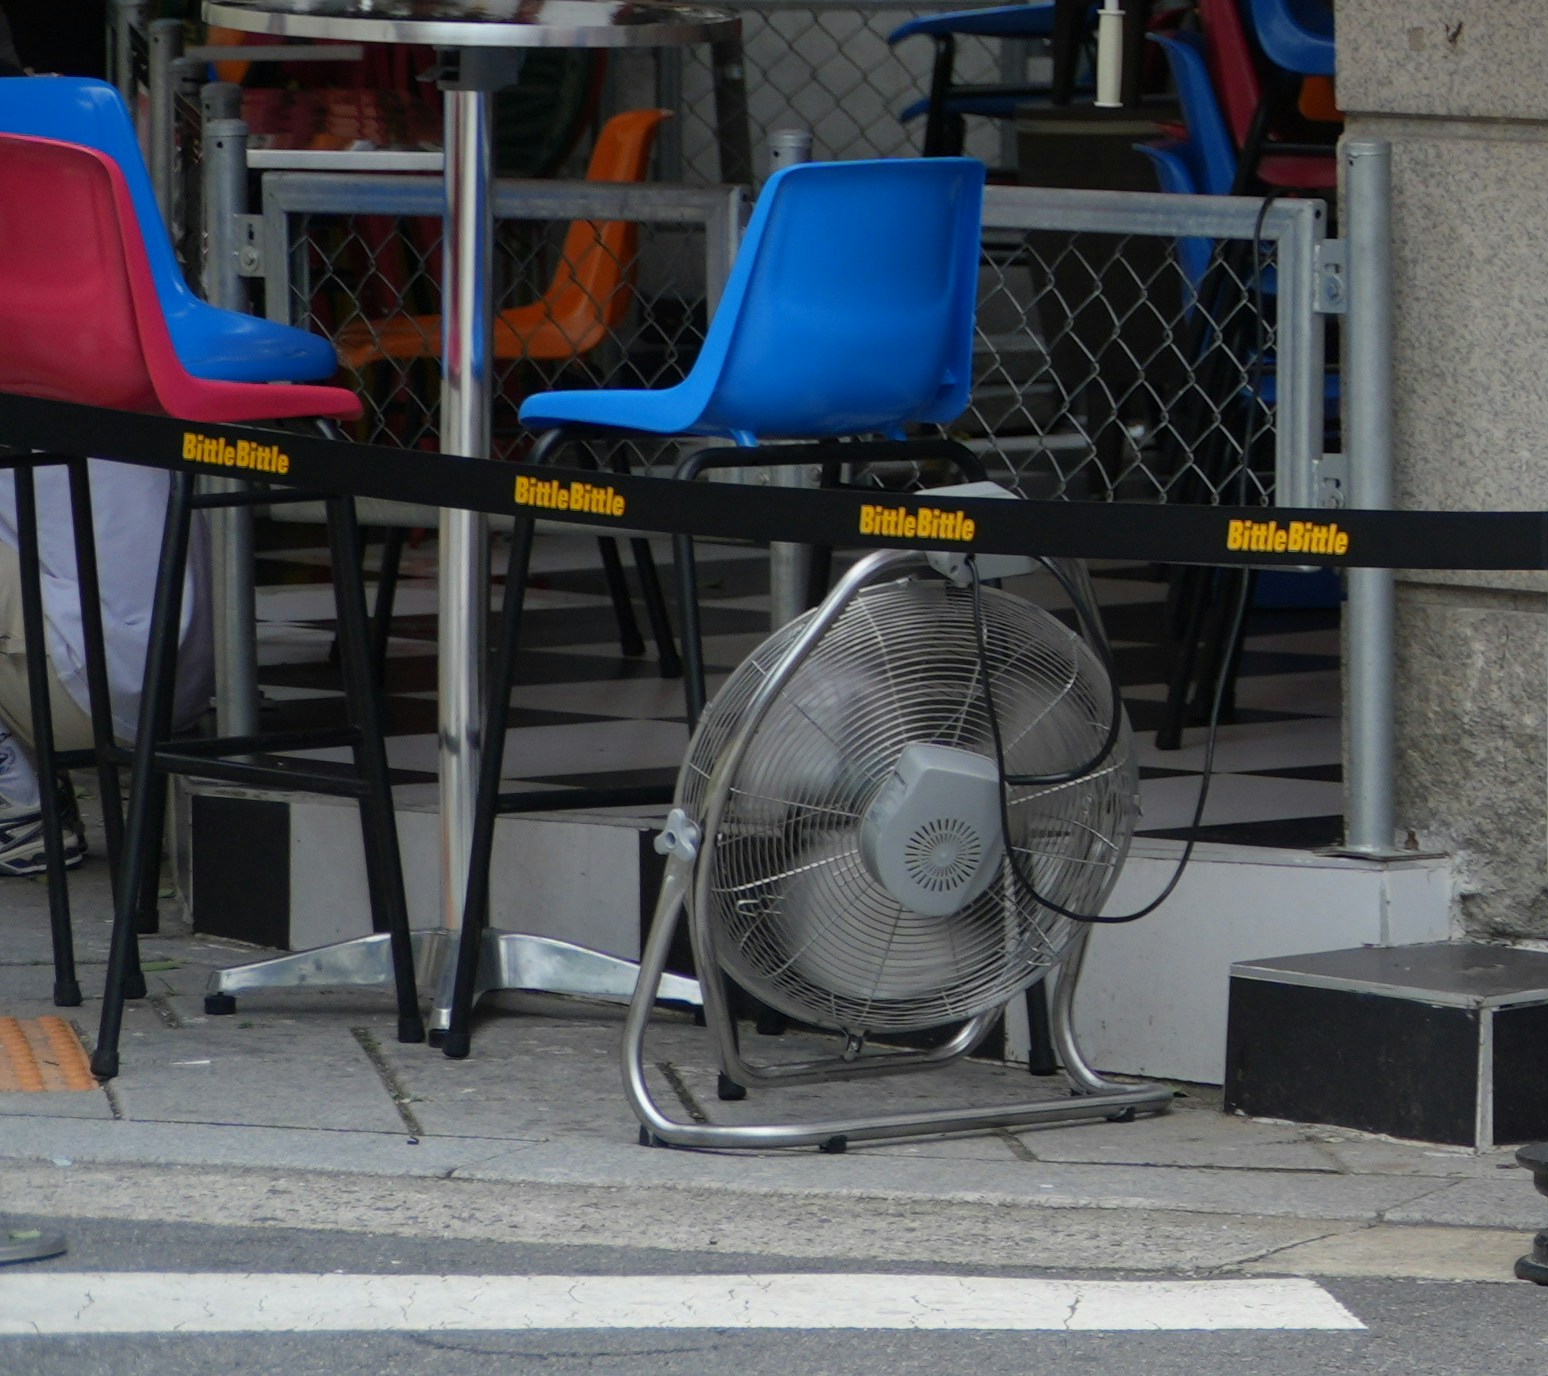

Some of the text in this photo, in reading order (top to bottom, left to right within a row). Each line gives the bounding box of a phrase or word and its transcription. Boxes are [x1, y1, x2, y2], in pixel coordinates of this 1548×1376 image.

[183, 432, 289, 475] BittleBittle
[515, 476, 626, 516] BittleBittle
[859, 504, 975, 542] BittleBittle
[1227, 519, 1349, 556] BittleBittle
